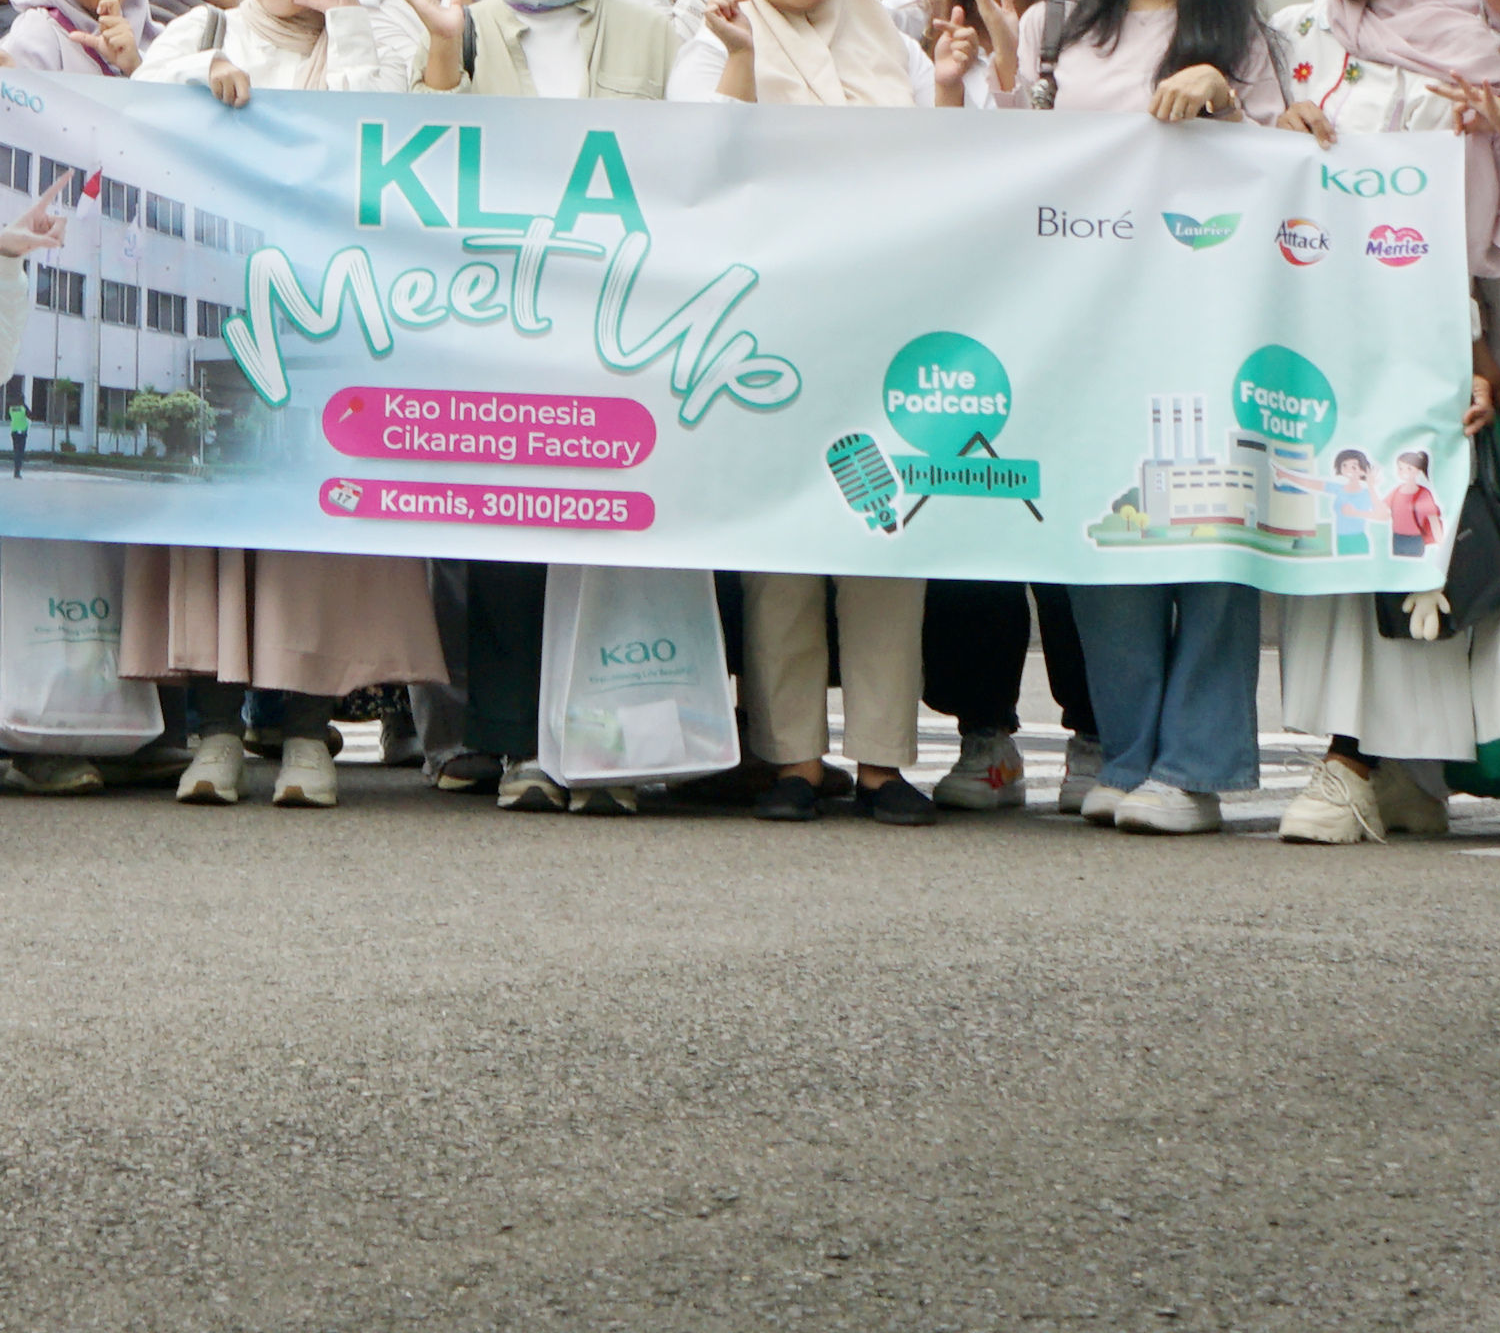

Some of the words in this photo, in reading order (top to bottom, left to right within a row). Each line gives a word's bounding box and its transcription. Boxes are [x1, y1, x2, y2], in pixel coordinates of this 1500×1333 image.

[1, 81, 45, 114] kao
[357, 122, 648, 232] KLA
[1320, 163, 1428, 198] kao
[1037, 206, 1134, 240] Bioré
[1174, 220, 1234, 238] Laurier
[1273, 220, 1330, 251] Attack
[1365, 239, 1429, 256] Merries
[223, 216, 605, 407] Meet
[594, 230, 801, 426] Up
[918, 364, 976, 390] Live
[384, 393, 441, 421] Kao
[449, 396, 596, 427] Indonesia
[887, 389, 1008, 416] Podcast
[1240, 381, 1330, 423] Factory
[1259, 408, 1307, 439] Tour
[382, 425, 518, 460] Cikarang
[527, 431, 640, 466] Factory
[381, 489, 475, 519] Kamis,
[482, 492, 628, 522] 30|10|2025
[48, 596, 109, 621] kao
[600, 638, 677, 667] kao
